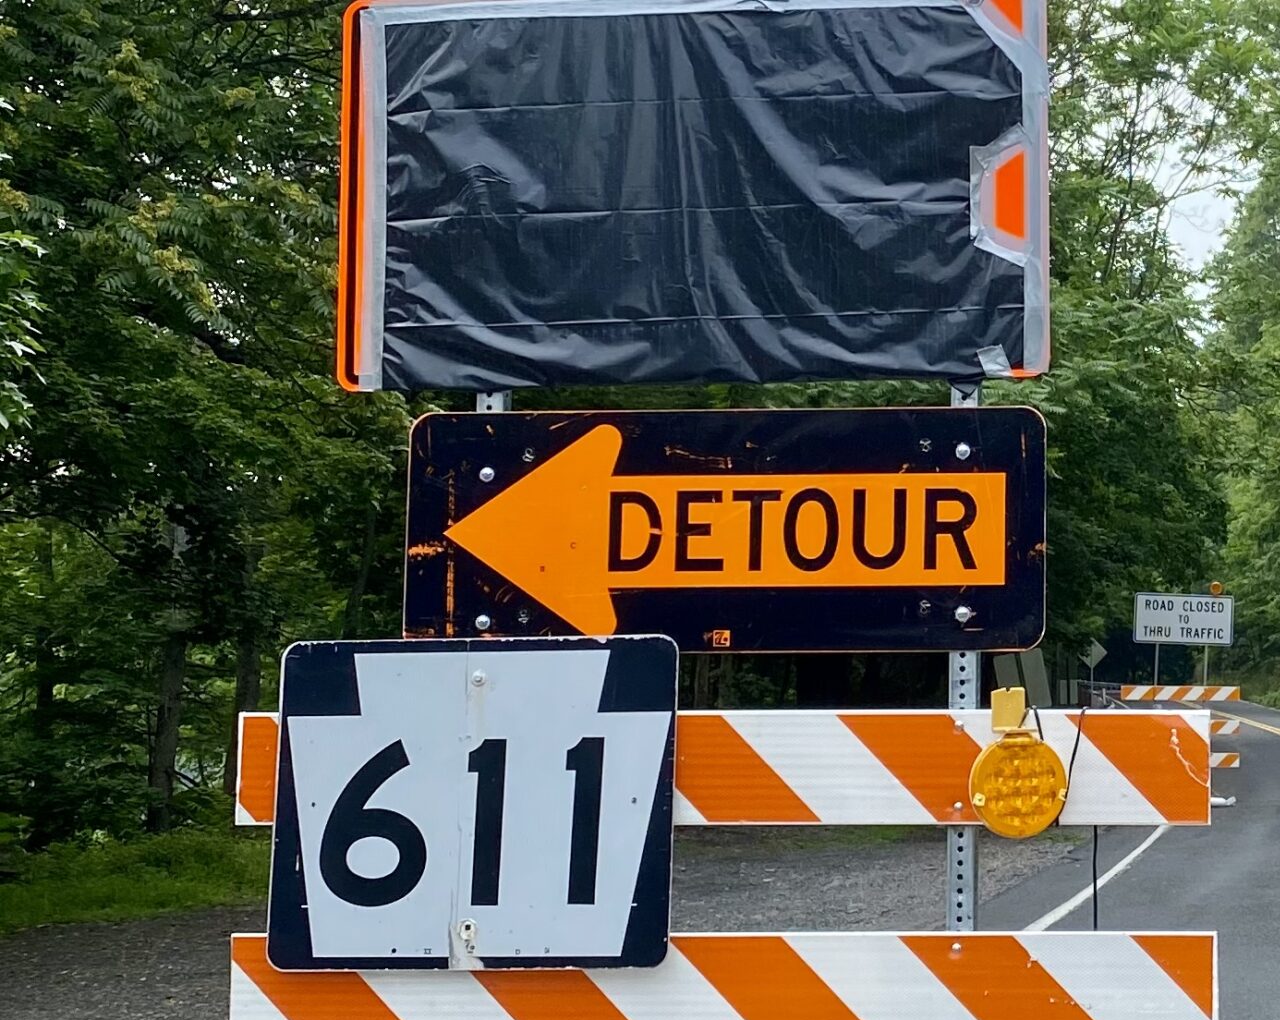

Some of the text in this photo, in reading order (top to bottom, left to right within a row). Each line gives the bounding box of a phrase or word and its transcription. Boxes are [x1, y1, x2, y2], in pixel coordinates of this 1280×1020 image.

[607, 487, 978, 572] DETOUR
[1144, 599, 1225, 613] ROAD CLOSED
[1178, 614, 1190, 625] TO
[1143, 625, 1224, 640] THRU TRAFFIC
[319, 736, 605, 907] 611
